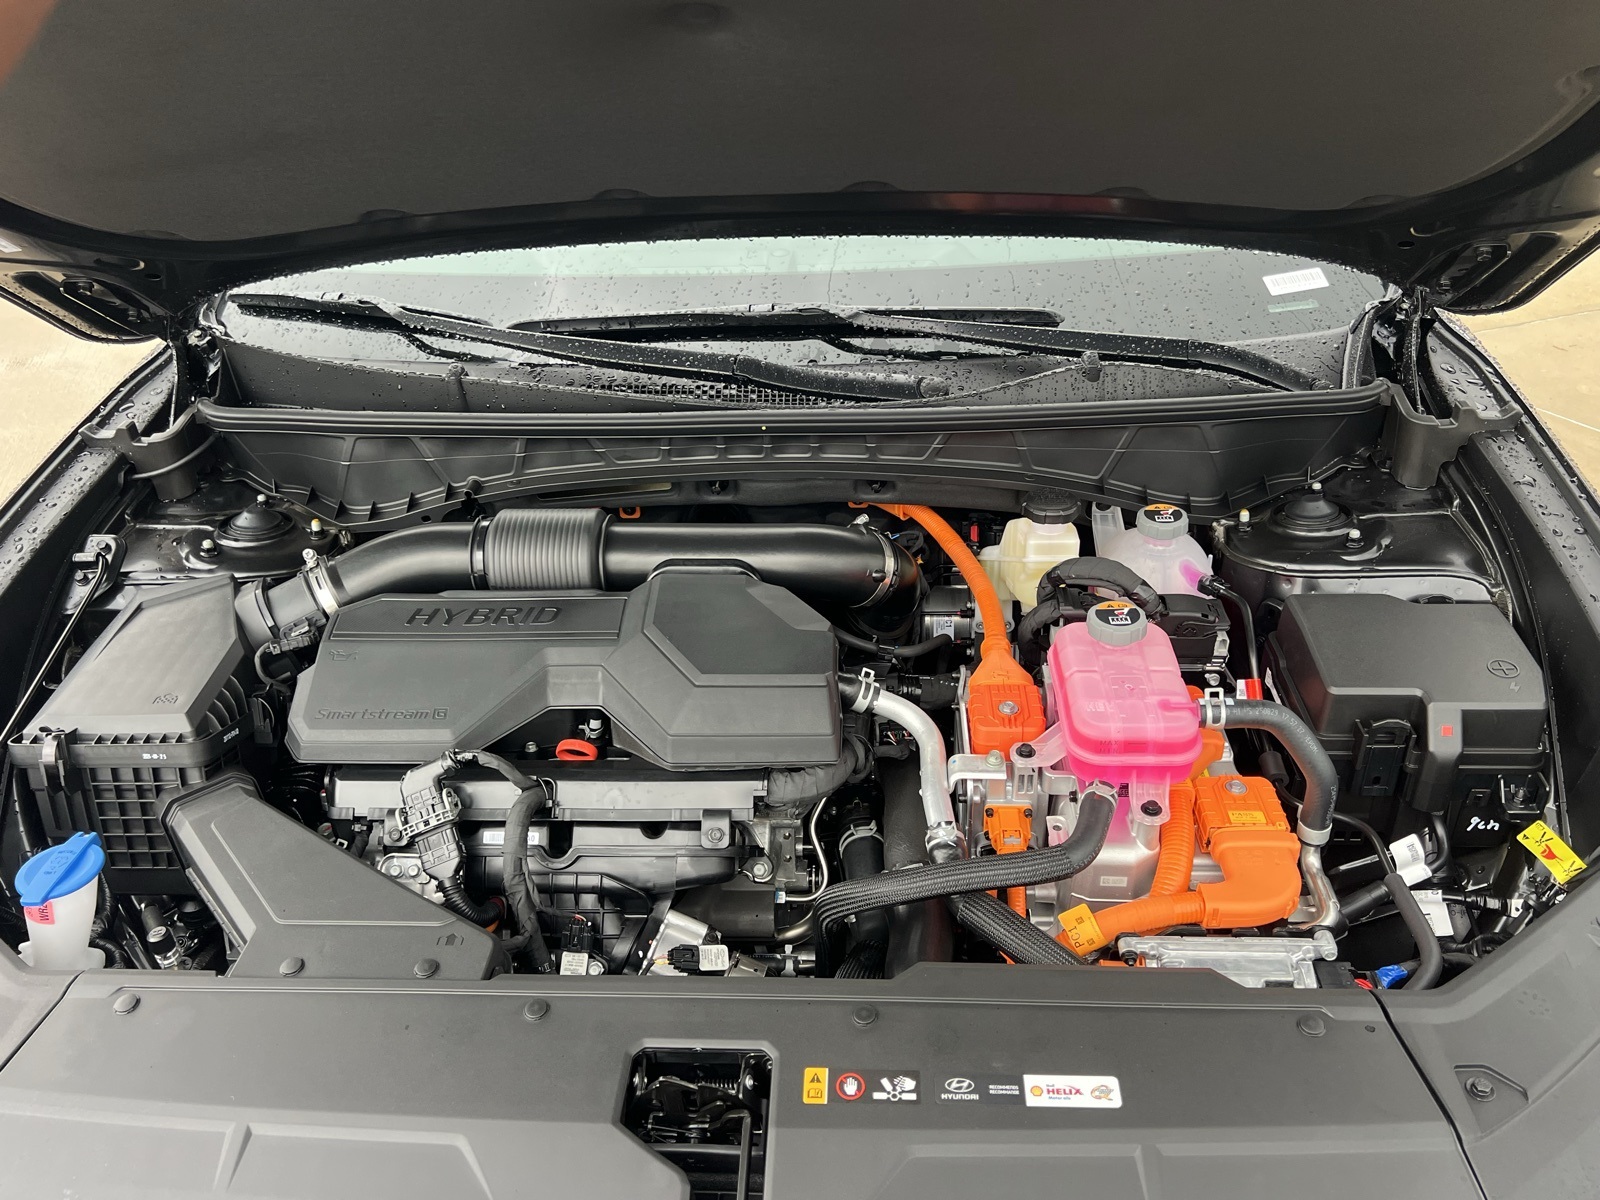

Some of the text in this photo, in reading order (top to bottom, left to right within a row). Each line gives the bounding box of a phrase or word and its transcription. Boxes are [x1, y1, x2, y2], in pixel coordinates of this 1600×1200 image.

[404, 607, 562, 627] HYBRID
[314, 708, 430, 720] Smartstream
[1068, 925, 1085, 949] PC1
[1046, 1087, 1084, 1096] HELIX
